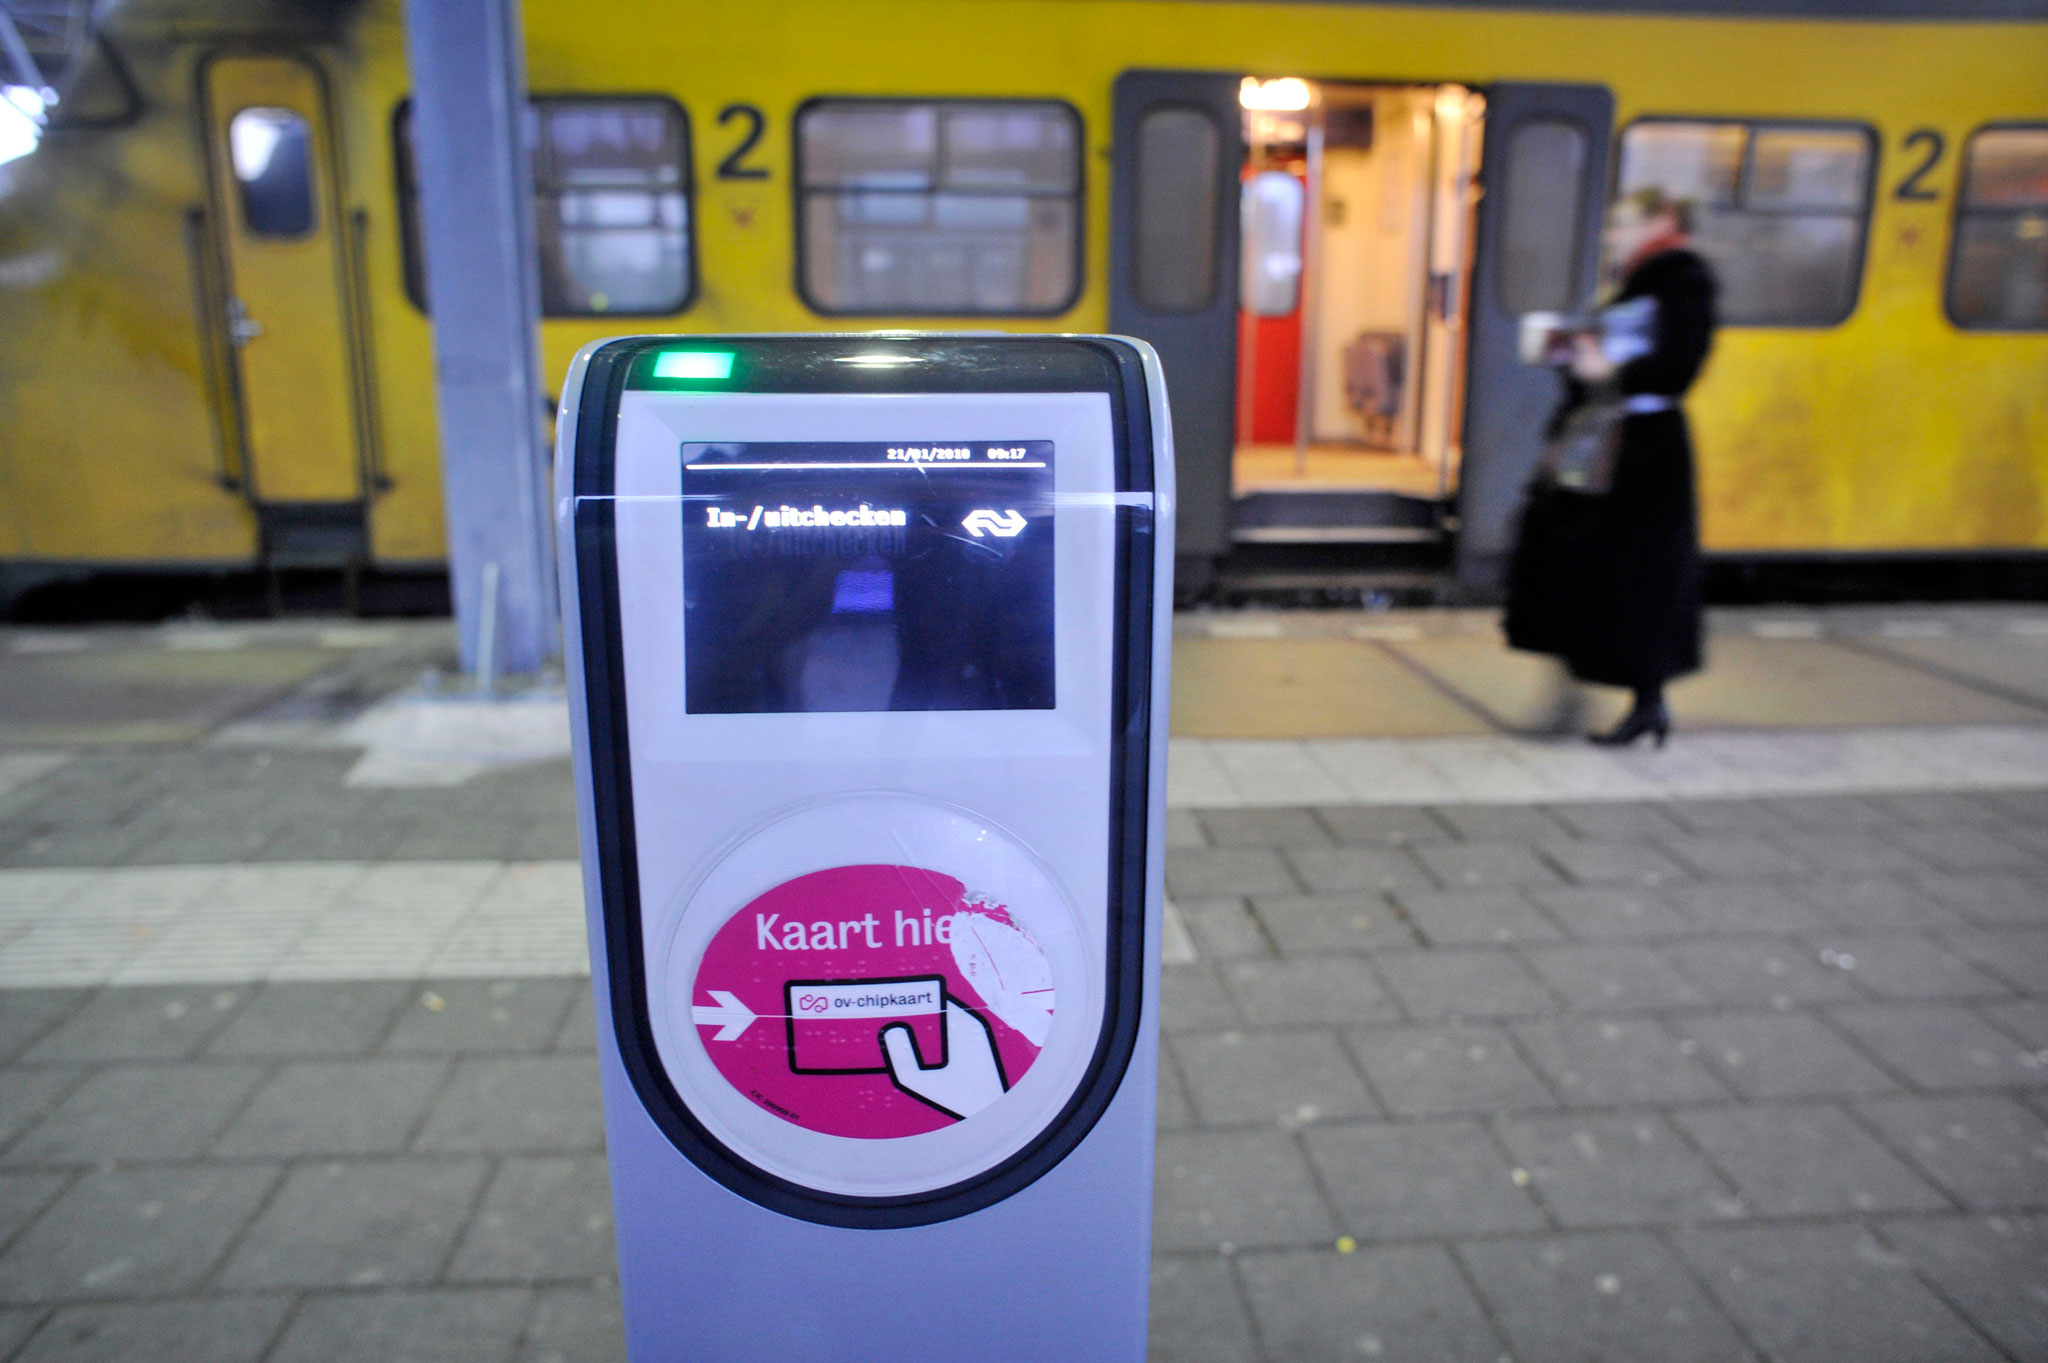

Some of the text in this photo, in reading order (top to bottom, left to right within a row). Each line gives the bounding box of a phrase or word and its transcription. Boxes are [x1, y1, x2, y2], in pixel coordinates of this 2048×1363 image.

[716, 104, 769, 179] 2
[1895, 127, 1944, 200] 2
[706, 505, 907, 530] In-/uitchecken
[756, 912, 882, 951] Kaart
[834, 992, 932, 1008] ov-chipkaart
